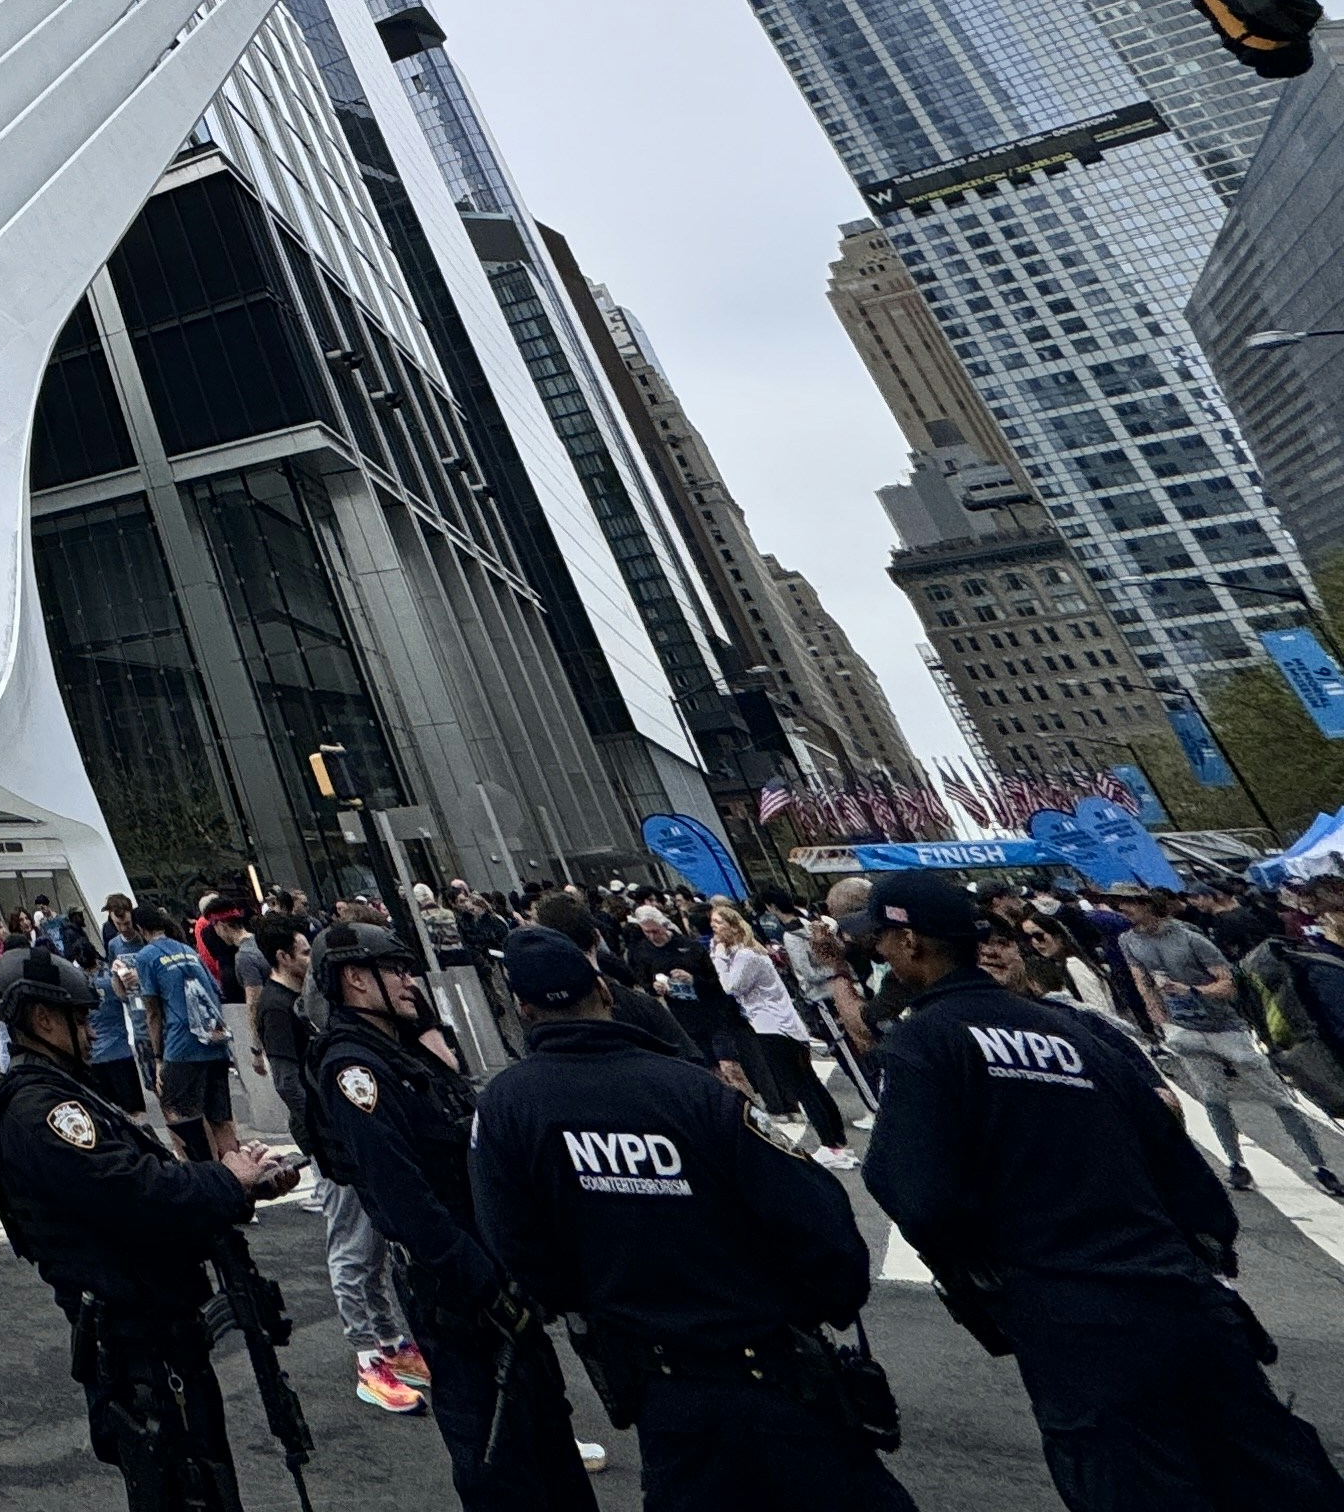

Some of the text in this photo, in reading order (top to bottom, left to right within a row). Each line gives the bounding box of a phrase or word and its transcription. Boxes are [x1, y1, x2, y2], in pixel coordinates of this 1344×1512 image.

[915, 845, 1007, 865] FINISH
[968, 1026, 1083, 1074] NYPD
[562, 1131, 682, 1176] NYPD
[579, 1175, 693, 1196] COUNTERTERRORISM
